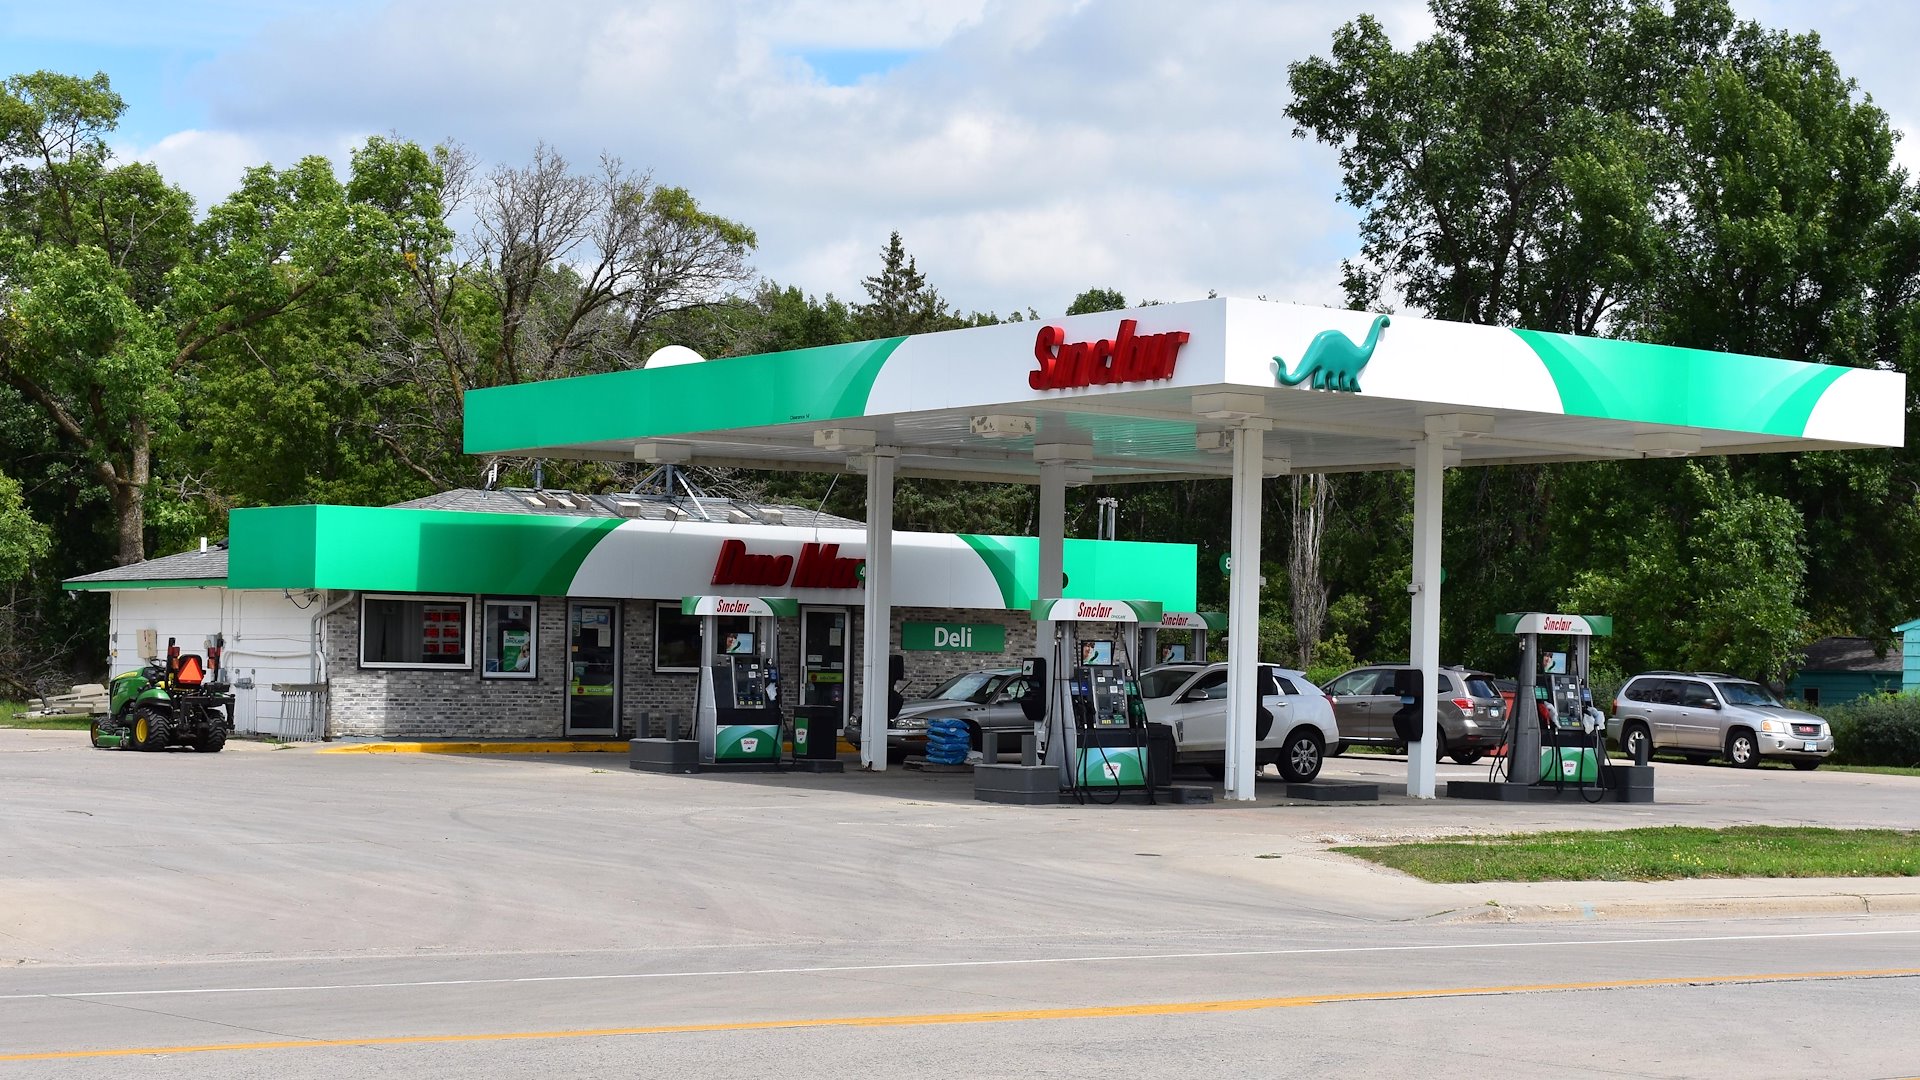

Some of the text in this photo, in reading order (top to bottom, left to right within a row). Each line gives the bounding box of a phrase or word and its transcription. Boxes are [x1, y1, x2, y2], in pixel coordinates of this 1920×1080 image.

[1029, 319, 1190, 391] Sinclair
[717, 599, 749, 613] Sinclair
[1077, 601, 1113, 618] Sinclair
[1161, 613, 1189, 626] Sinclair
[1543, 616, 1572, 631] Sinclair
[934, 626, 972, 648] Deli
[1126, 669, 1132, 677] 8
